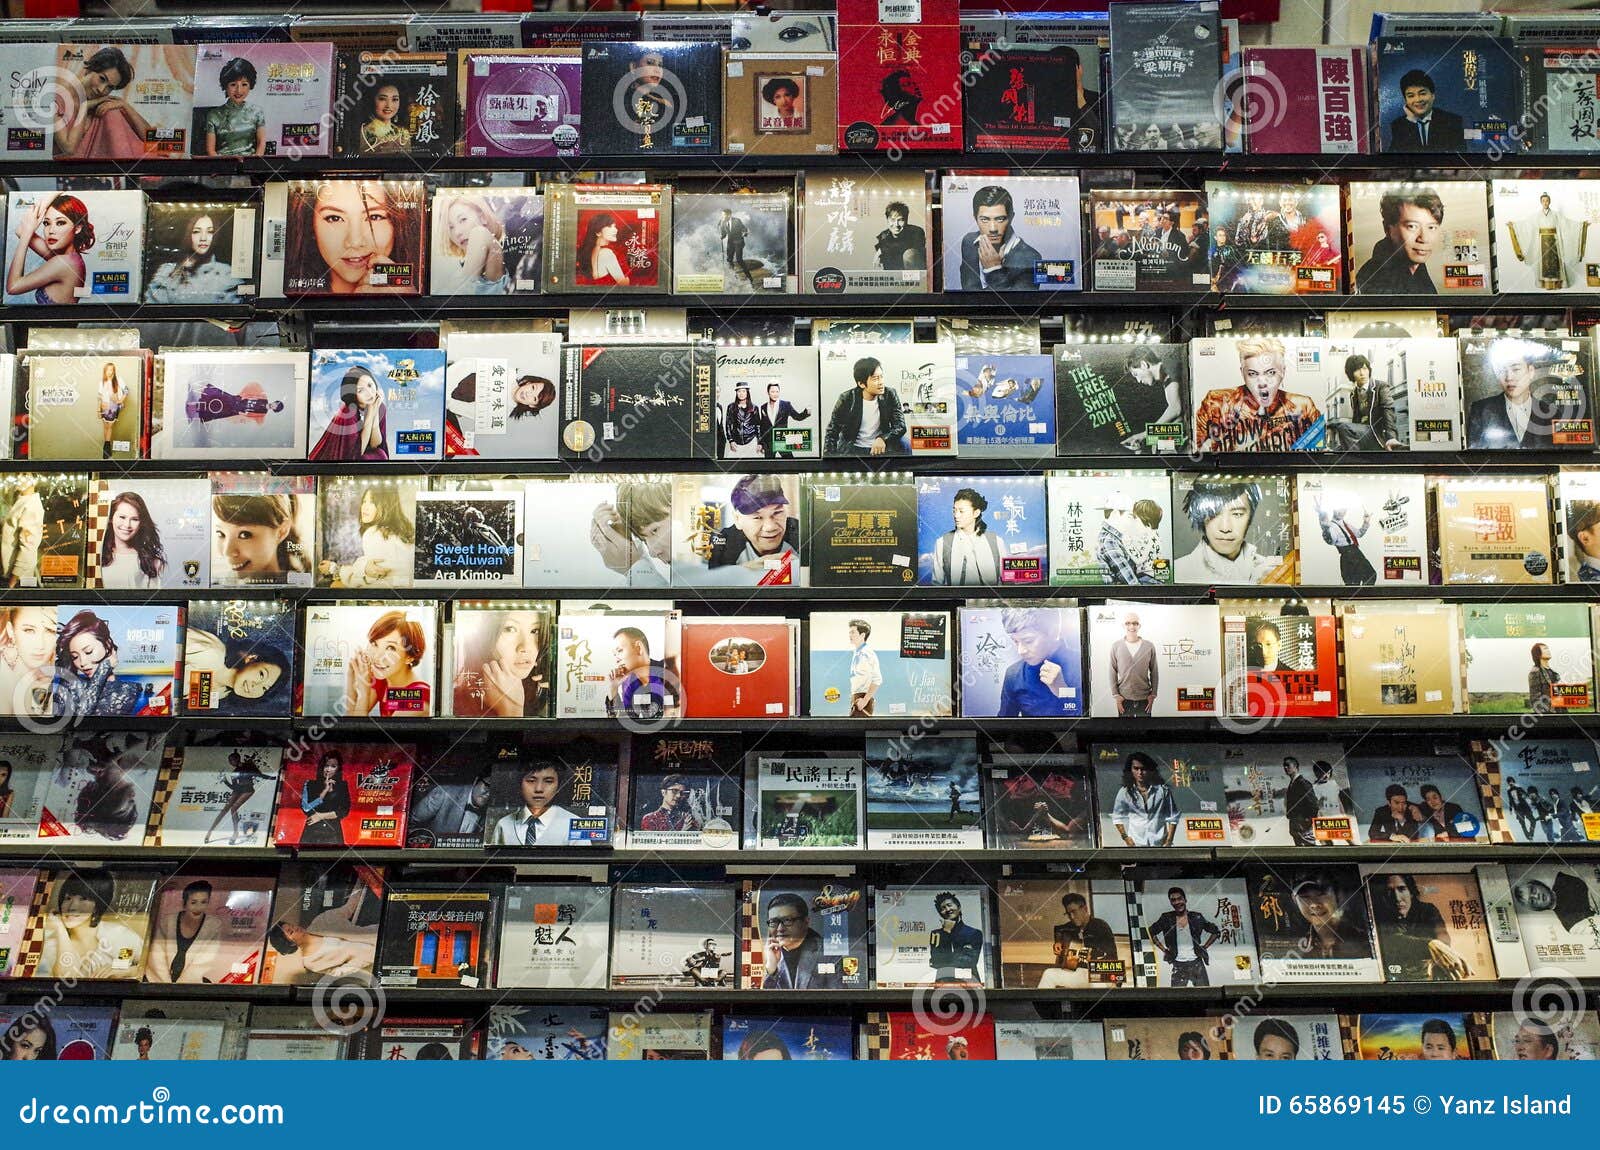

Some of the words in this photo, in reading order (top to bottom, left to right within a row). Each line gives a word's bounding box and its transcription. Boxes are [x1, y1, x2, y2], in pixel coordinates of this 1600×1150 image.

[10, 71, 47, 90] Sally
[1321, 57, 1353, 142] 陳百強
[716, 354, 785, 367] Grasshopper
[1069, 363, 1096, 384] THE
[964, 404, 1037, 424] 無與倫比
[1089, 404, 1118, 429] 2014
[1067, 502, 1085, 552] 林志颖
[435, 543, 476, 555] Sweet
[478, 543, 516, 555] Home
[434, 554, 503, 566] Ka-Aluwan
[434, 569, 456, 580] Ara
[459, 569, 501, 580] Kimbo
[1297, 622, 1314, 671] 林志炫
[573, 765, 593, 801] 郑源
[785, 765, 857, 783] 民謠王子
